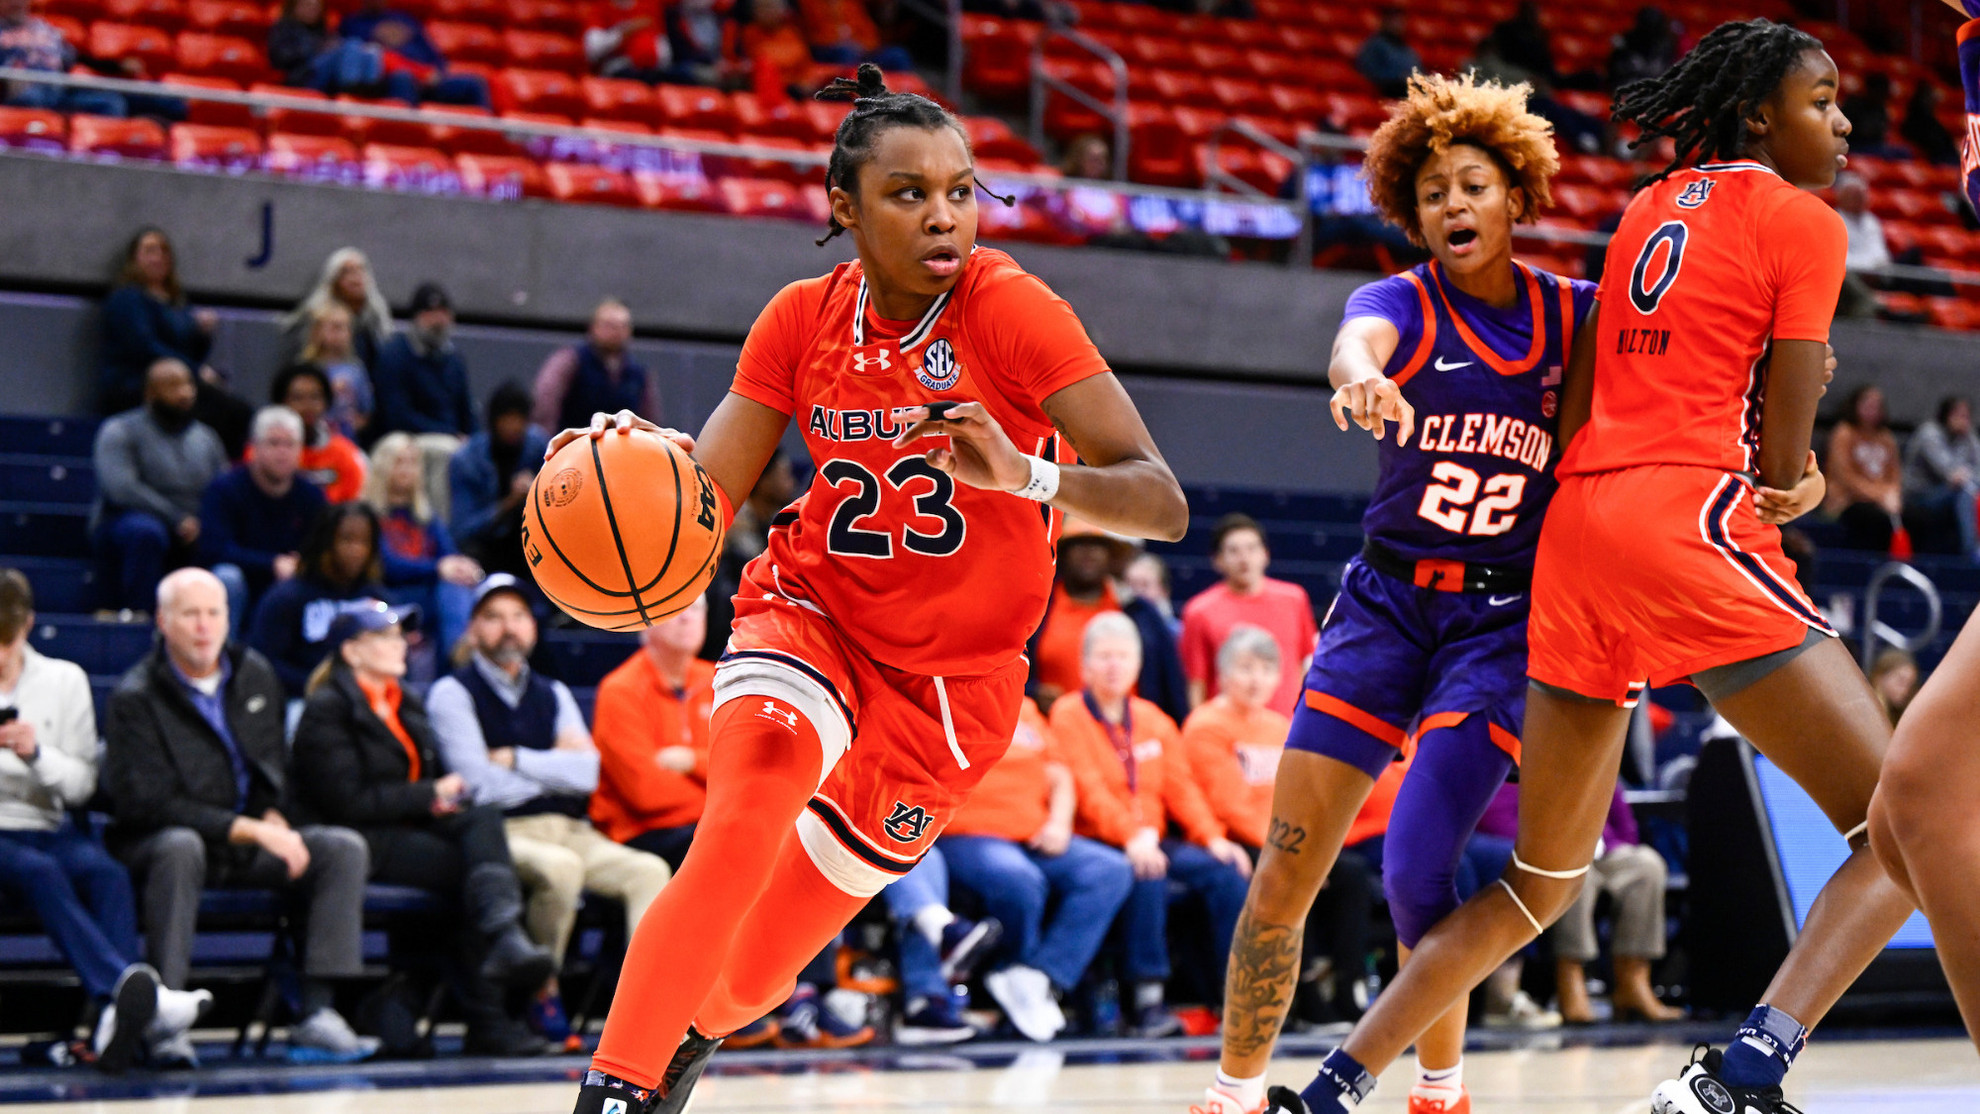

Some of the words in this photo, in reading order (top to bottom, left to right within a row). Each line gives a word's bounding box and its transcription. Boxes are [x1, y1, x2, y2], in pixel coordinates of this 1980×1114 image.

[246, 201, 272, 269] J
[1628, 220, 1689, 316] 0
[919, 373, 958, 390] GRADUATE
[925, 339, 954, 377] SEC
[809, 404, 949, 442] AUBU
[1418, 413, 1553, 473] CLEMSON
[689, 454, 716, 532] CAA
[819, 454, 967, 560] 23
[1417, 460, 1528, 537] 22
